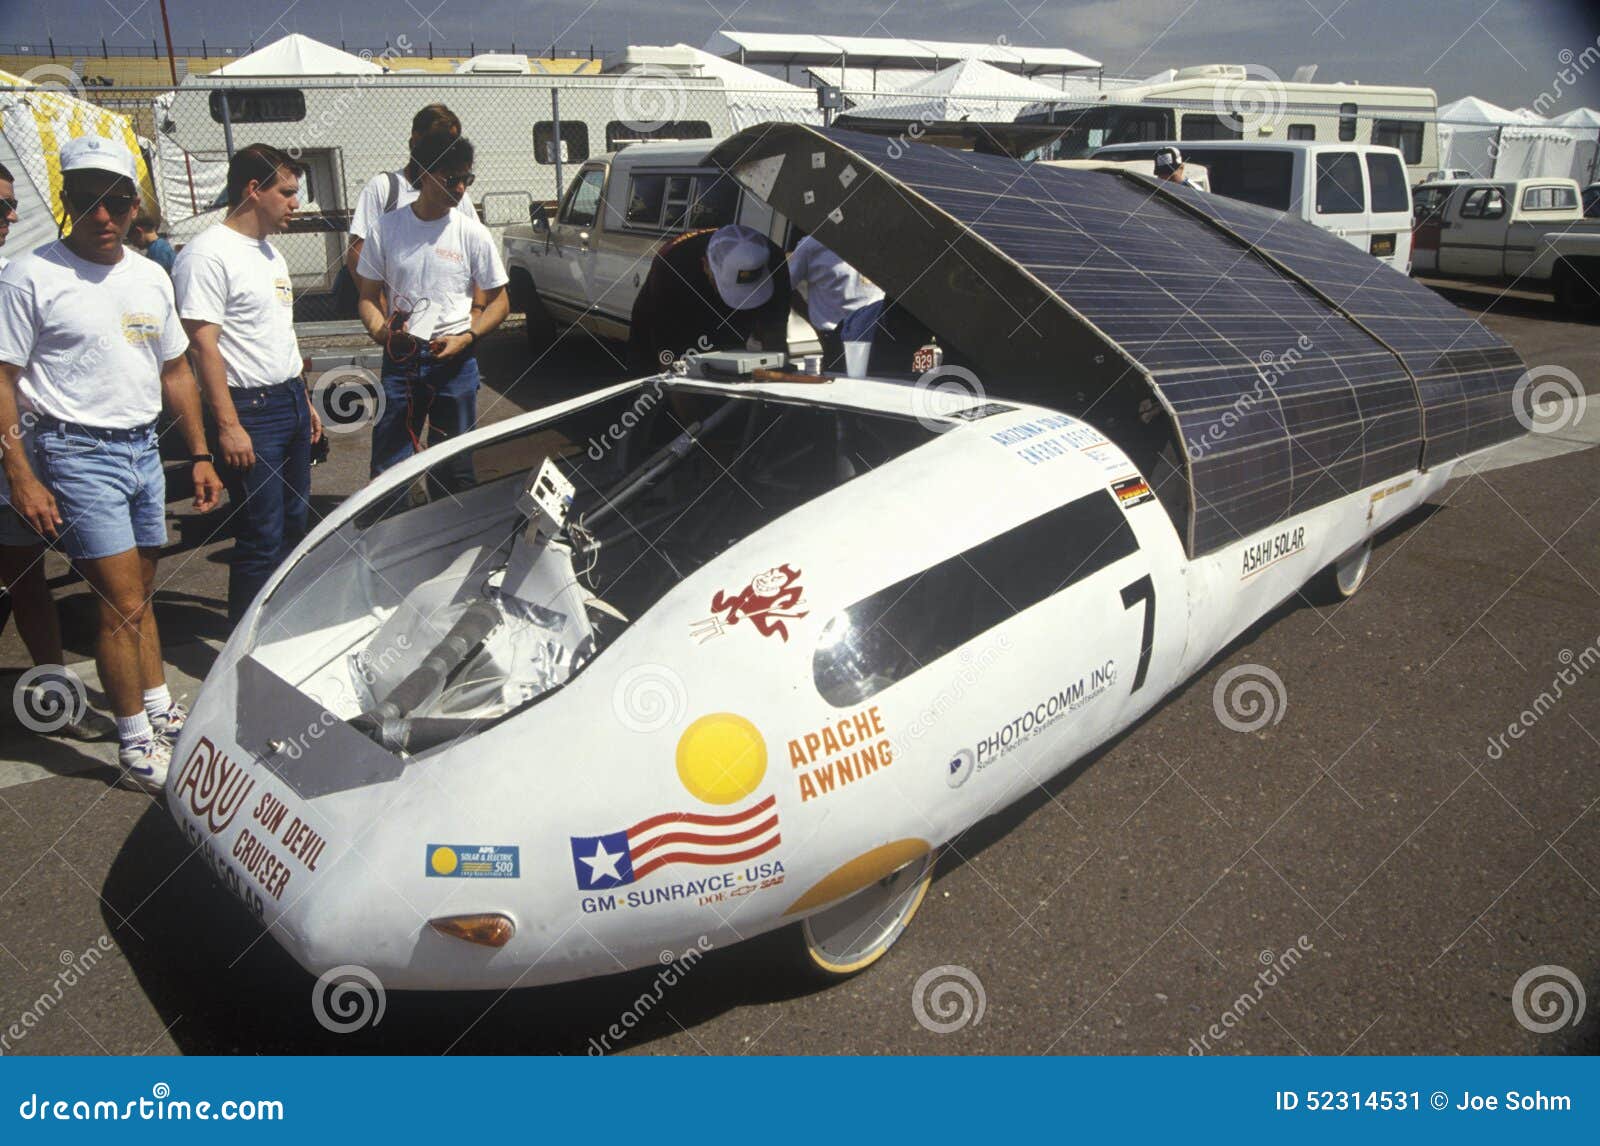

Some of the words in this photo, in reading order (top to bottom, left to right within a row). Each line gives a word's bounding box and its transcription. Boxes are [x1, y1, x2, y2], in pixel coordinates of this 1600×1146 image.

[914, 354, 933, 369] 929
[1242, 539, 1272, 574] ASAHI
[1273, 526, 1305, 558] SOLAR
[1119, 573, 1156, 696] 7
[787, 706, 885, 769] APACHE
[977, 679, 1085, 761] PHOTOCOMM
[799, 739, 893, 802] AWNING
[253, 792, 288, 835] SUN
[281, 816, 326, 873] DEVIL
[232, 828, 291, 901] CRUISER
[495, 861, 514, 873] 500
[582, 895, 616, 913] GM
[627, 872, 736, 908] SUNRAYCE
[745, 861, 785, 882] USA
